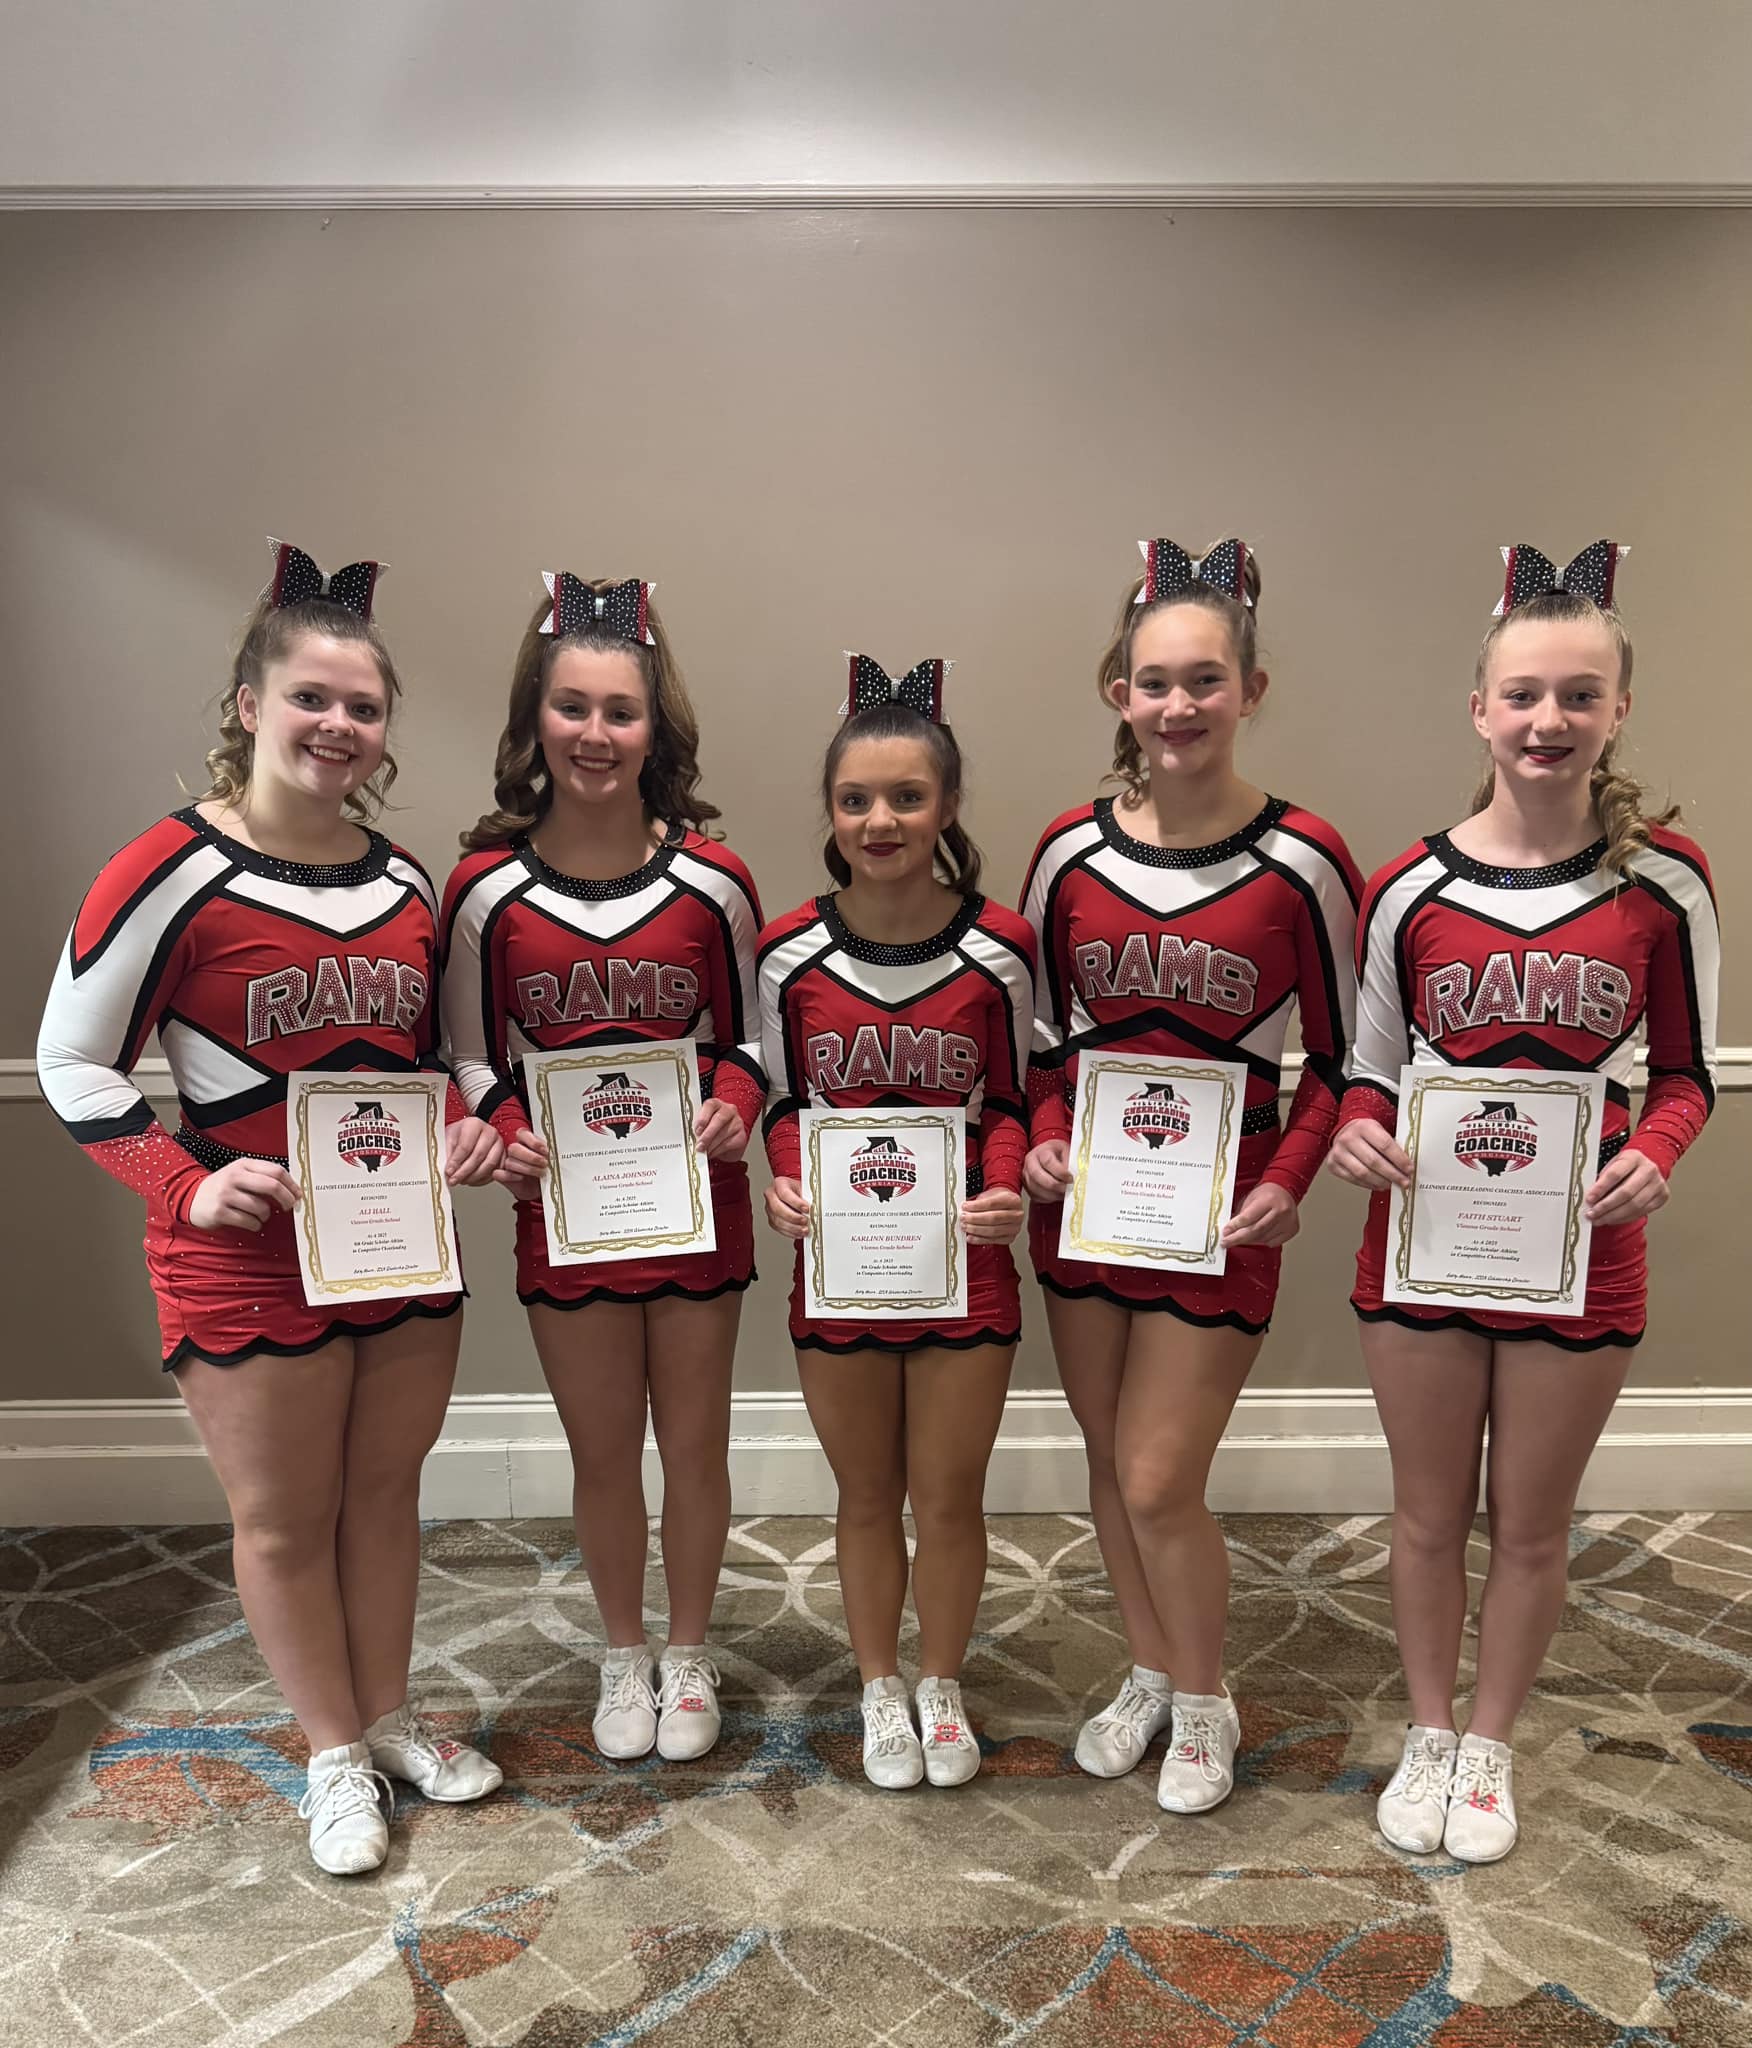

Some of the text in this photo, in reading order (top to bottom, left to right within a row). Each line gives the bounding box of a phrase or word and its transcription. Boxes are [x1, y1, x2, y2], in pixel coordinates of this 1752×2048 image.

[1075, 933, 1259, 1016] RAMS
[246, 955, 428, 1047] RAMS
[516, 958, 699, 1028] RAMS
[1426, 951, 1632, 1043] RAMS
[807, 1025, 979, 1094] RAMS
[583, 1096, 650, 1110] CHEERLEADING
[584, 1104, 652, 1123] COACHES
[1124, 1106, 1190, 1121] CHEERLEADING
[1122, 1114, 1190, 1133] COACHES
[338, 1127, 400, 1140] CHEERLEADING
[1456, 1128, 1537, 1143] CHEERLEADING
[338, 1135, 401, 1152] COACHES
[1454, 1137, 1537, 1157] COACHES
[621, 1170, 657, 1179] JOHNSON
[850, 1160, 916, 1171] CHEERLEADING
[850, 1168, 916, 1184] COACHES
